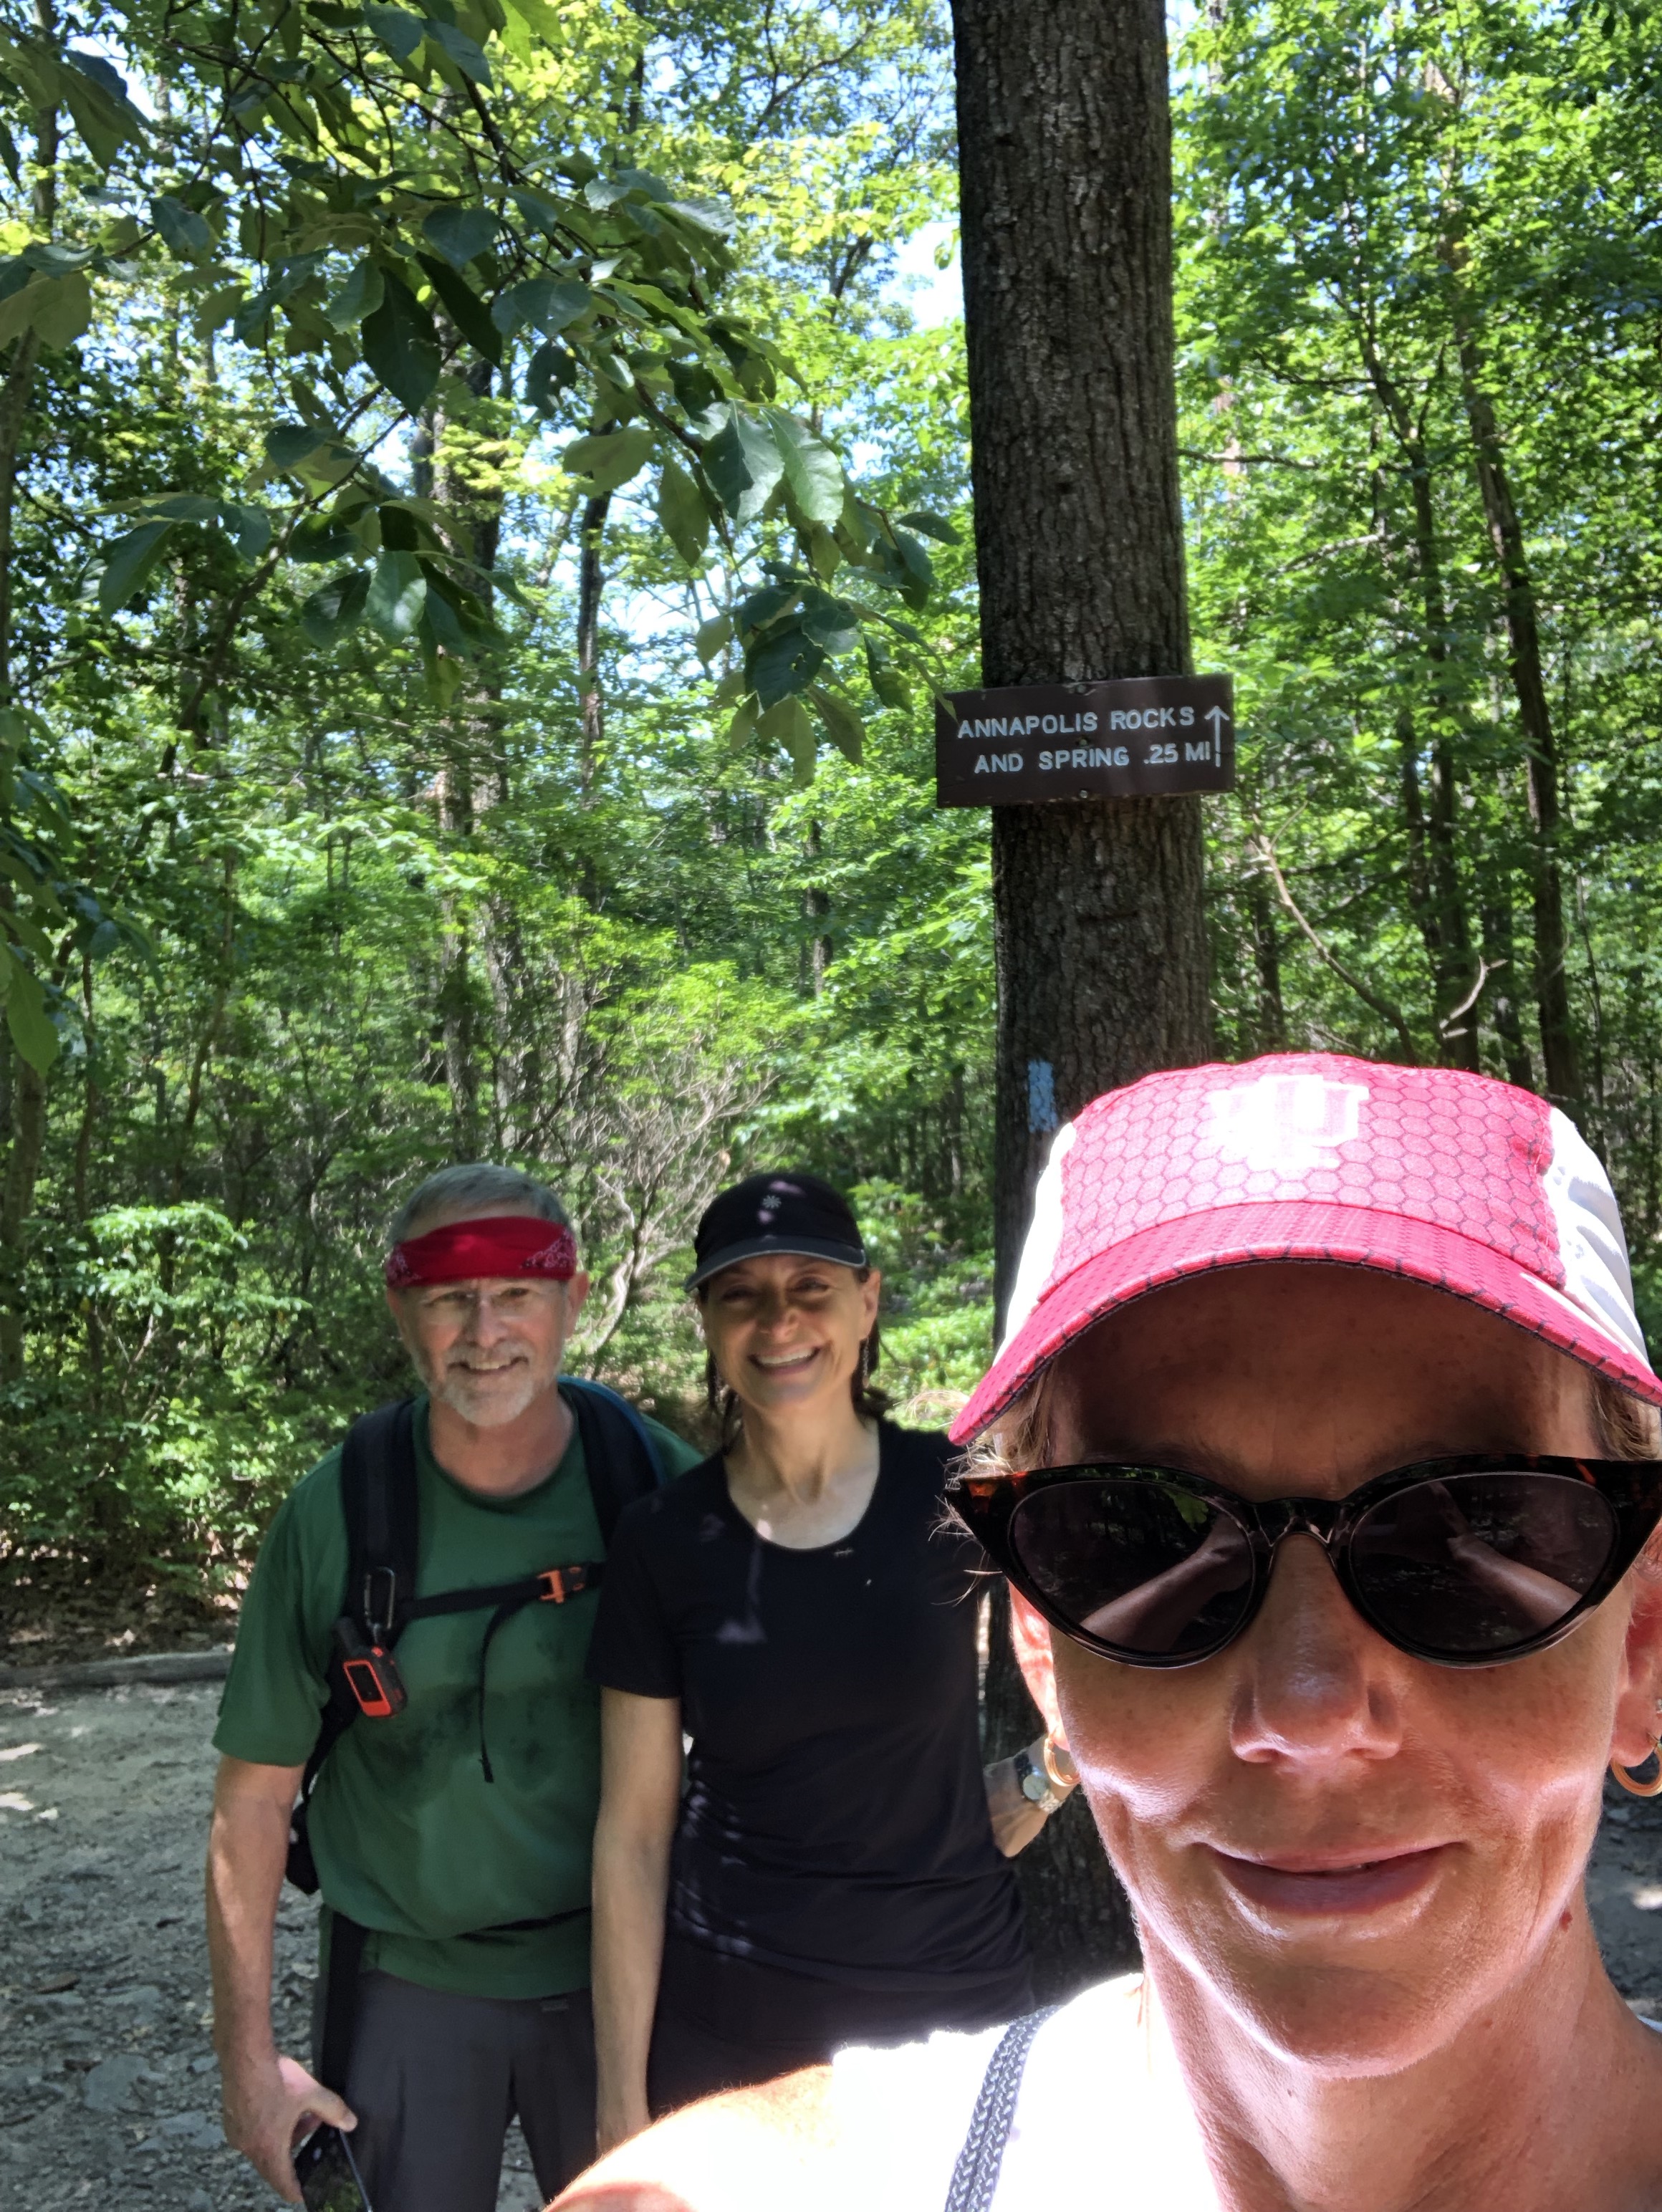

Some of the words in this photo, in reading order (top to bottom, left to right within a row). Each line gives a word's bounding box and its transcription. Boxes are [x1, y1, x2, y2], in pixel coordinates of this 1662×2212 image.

[957, 711, 1098, 739] ANNAPOLIS
[1110, 706, 1195, 731] ROCKS
[974, 753, 1024, 774] AND
[1038, 746, 1130, 771] SPRING
[1143, 743, 1178, 765] .25
[1185, 741, 1211, 762] MI
